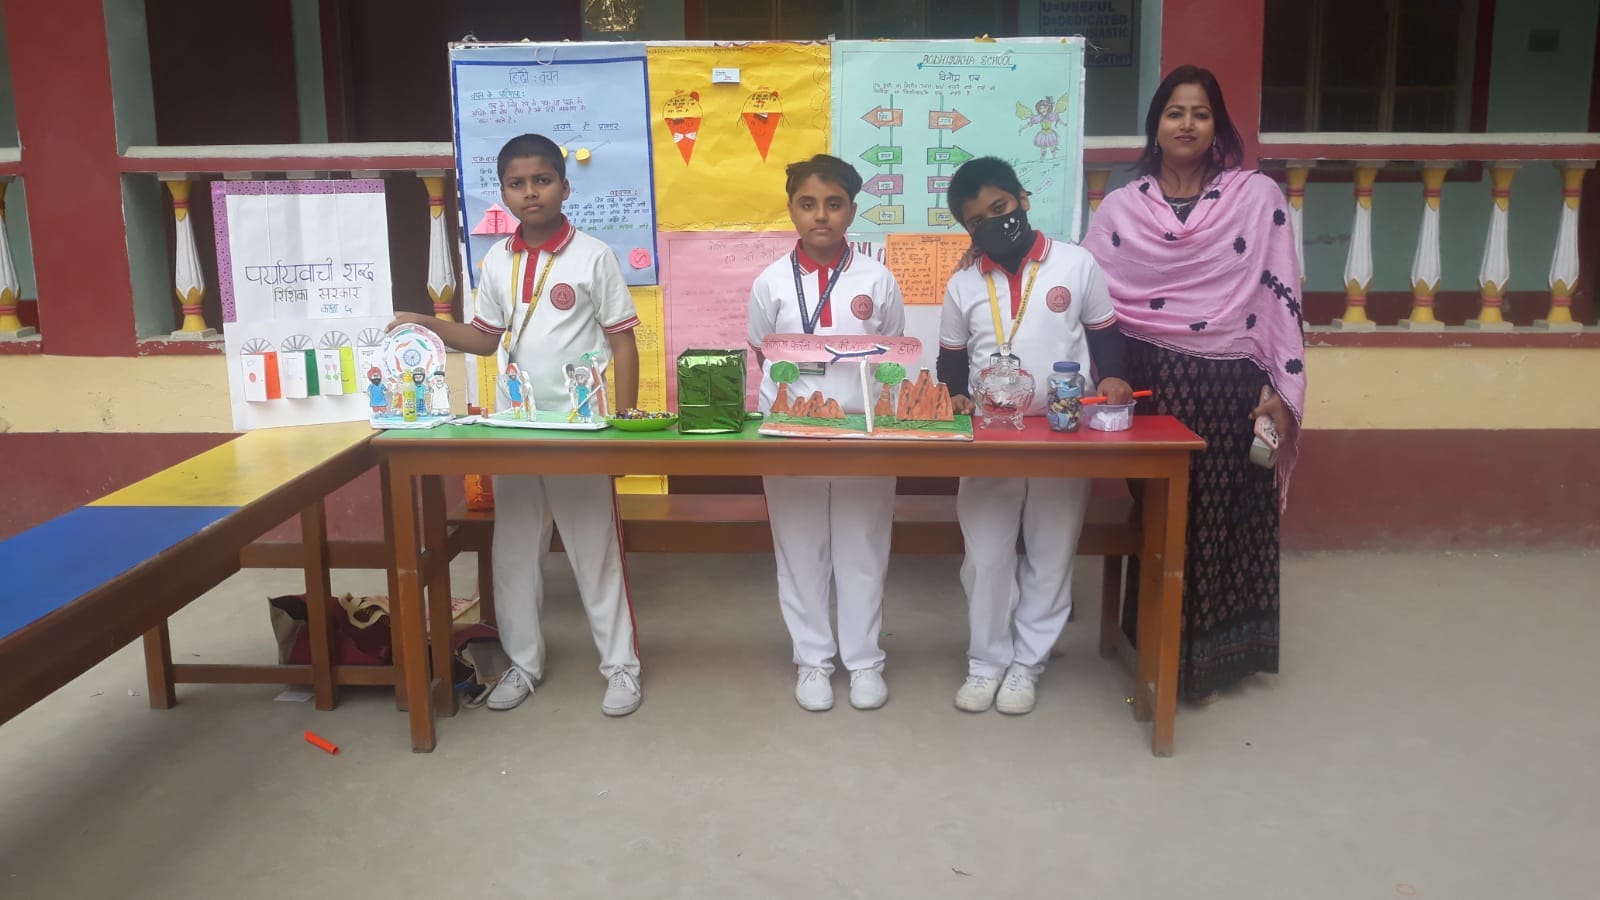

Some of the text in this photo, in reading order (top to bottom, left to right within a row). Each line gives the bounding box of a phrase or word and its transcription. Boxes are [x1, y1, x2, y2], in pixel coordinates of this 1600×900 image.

[980, 55, 1014, 66] SCHOOL
[244, 257, 376, 286] पर्यायवाची शब्द
[274, 286, 363, 303] रिशिका सरकार
